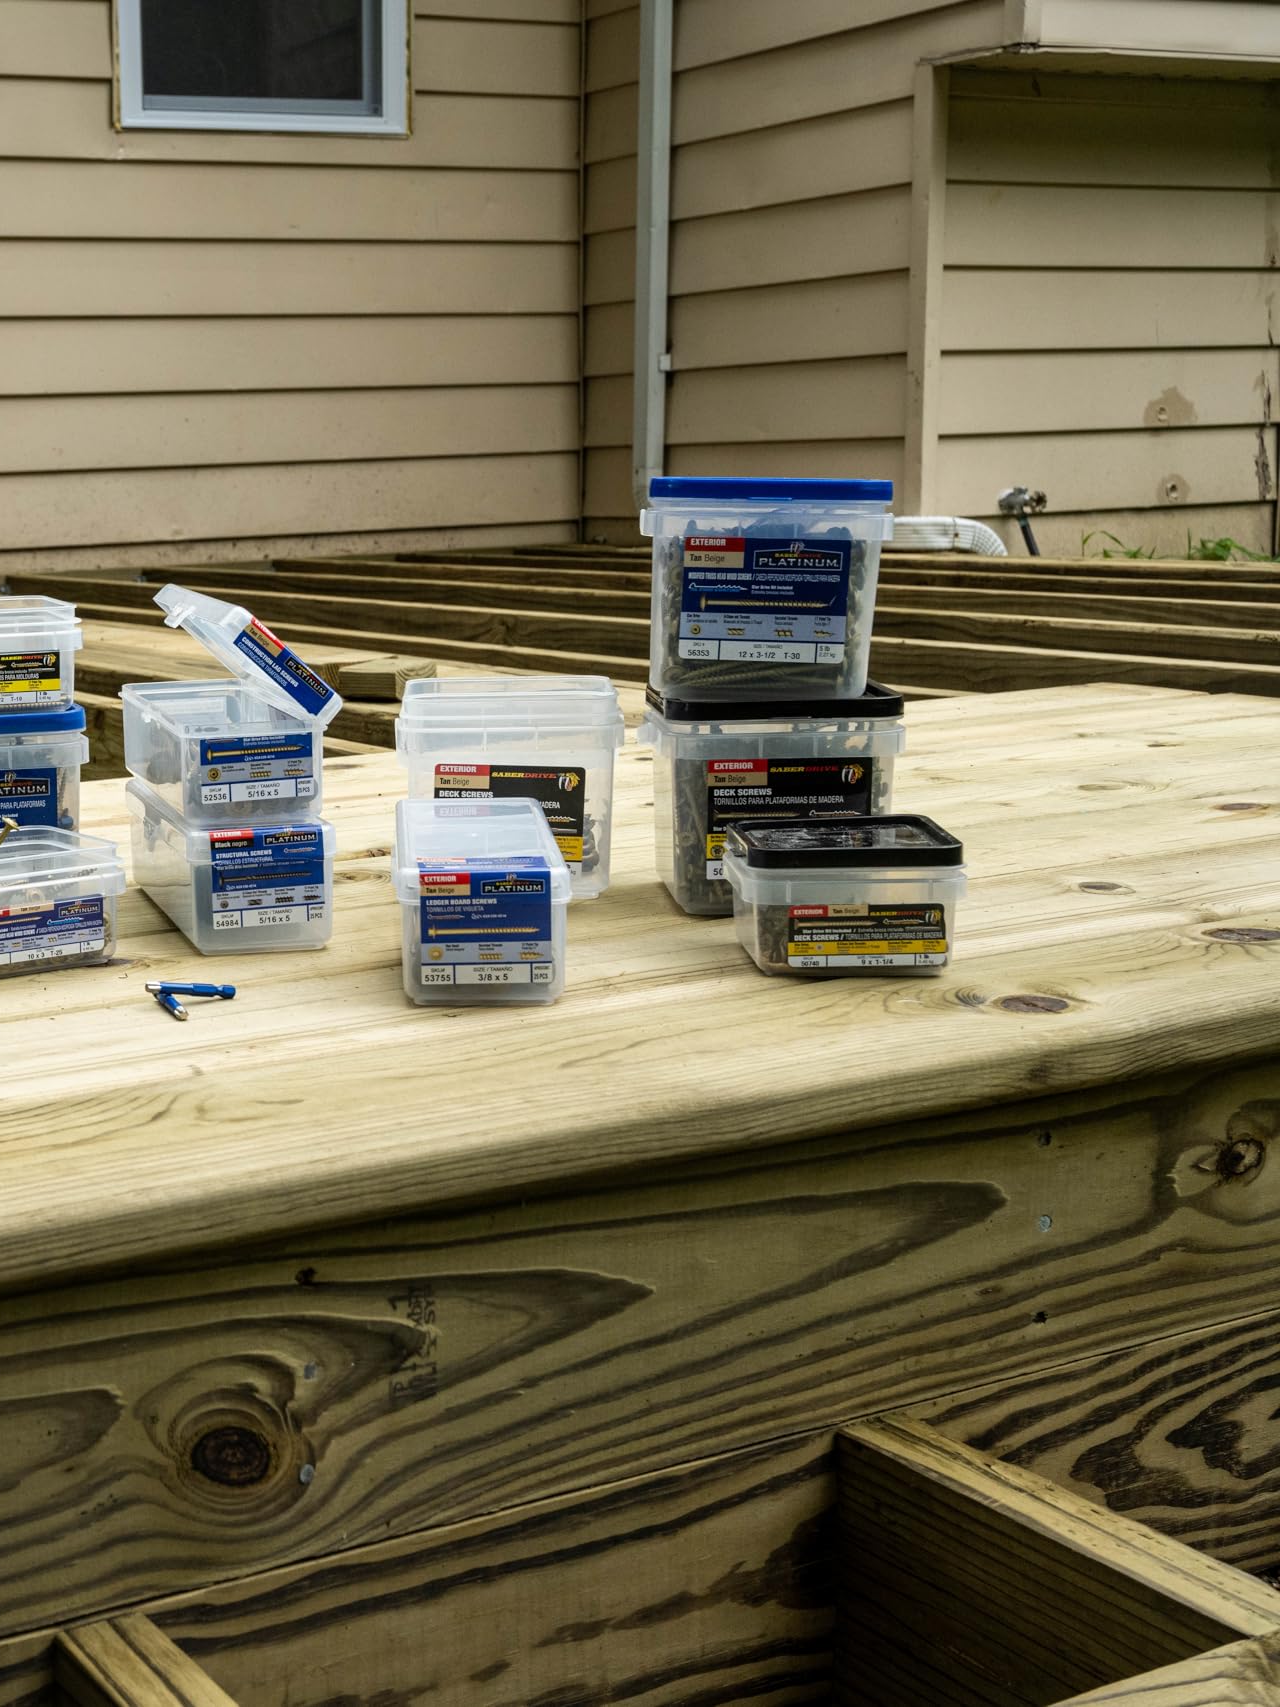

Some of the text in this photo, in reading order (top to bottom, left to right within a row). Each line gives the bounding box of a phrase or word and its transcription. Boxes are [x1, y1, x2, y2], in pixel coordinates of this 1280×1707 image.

[704, 554, 725, 563] Beige
[241, 637, 299, 687] CONSTRUCTION LAG SCREWS
[287, 661, 326, 695] PLATINUM
[714, 762, 753, 770] EXTERIOR
[452, 778, 469, 786] Beige
[728, 775, 746, 783] Beige
[248, 789, 265, 798] 5/16
[13, 800, 46, 808] PLATAFORMAS
[766, 796, 808, 804] PLATAFORMAS
[266, 834, 316, 843] PLATINUM
[61, 906, 98, 915] PLATINUM
[259, 916, 276, 924] 5/16
[425, 974, 451, 982] 53755
